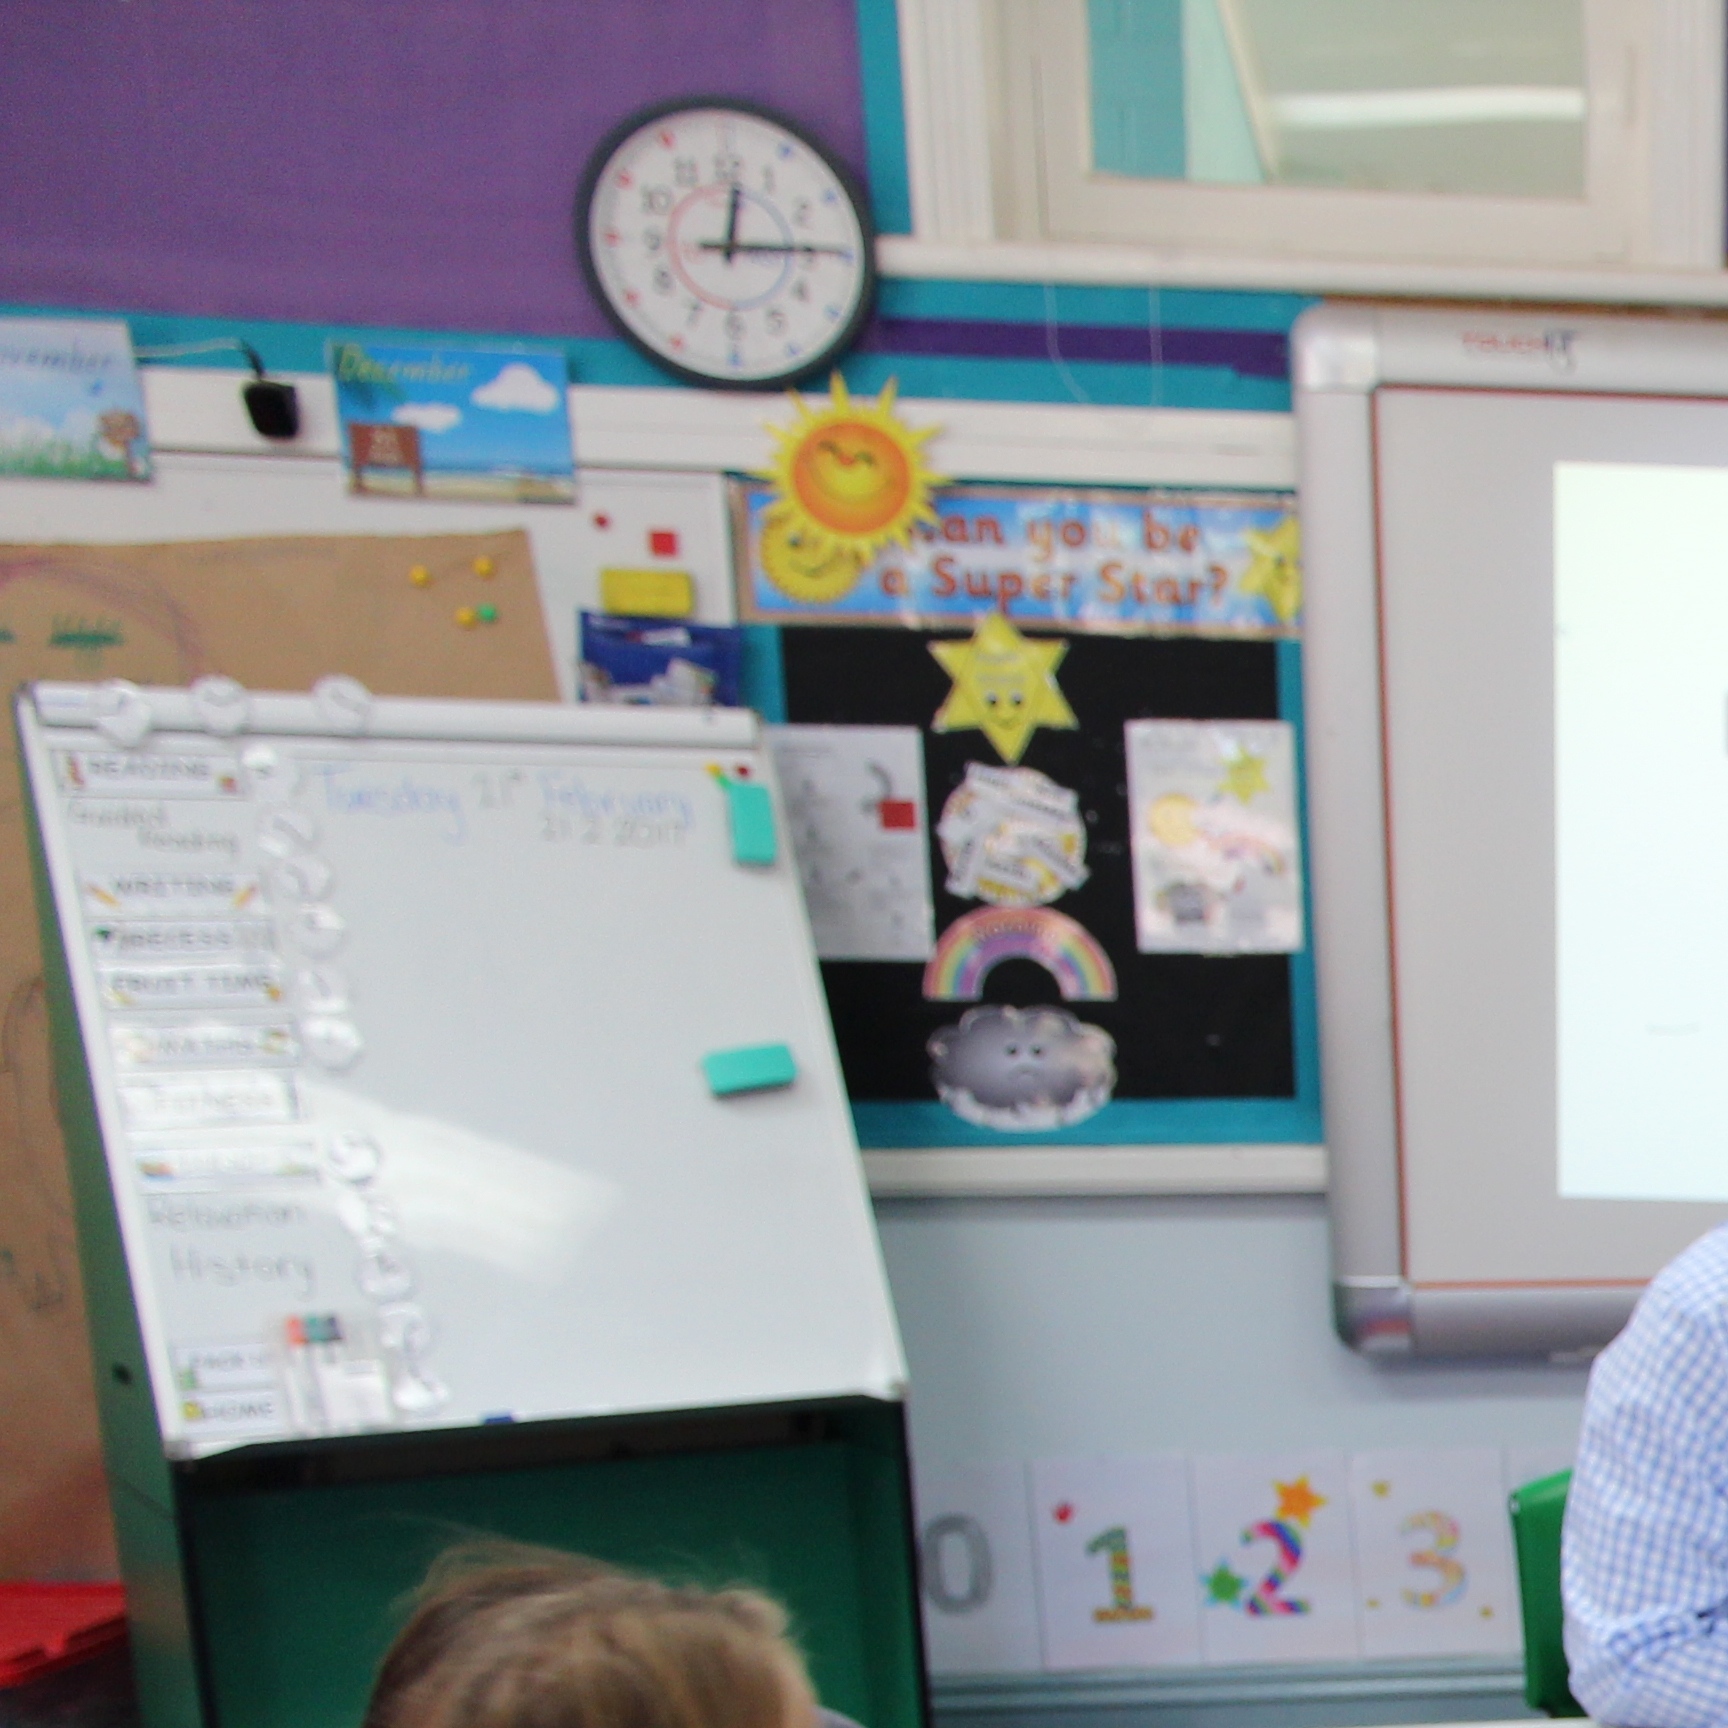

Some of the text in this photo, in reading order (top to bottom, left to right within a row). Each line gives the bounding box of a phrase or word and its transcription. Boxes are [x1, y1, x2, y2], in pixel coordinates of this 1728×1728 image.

[640, 183, 674, 216] 10
[1026, 515, 1125, 563] you
[1142, 506, 1202, 555] be
[879, 555, 1229, 616] a Super Star?
[170, 1244, 315, 1300] History
[922, 1510, 1468, 1624] 0 1 2 3
